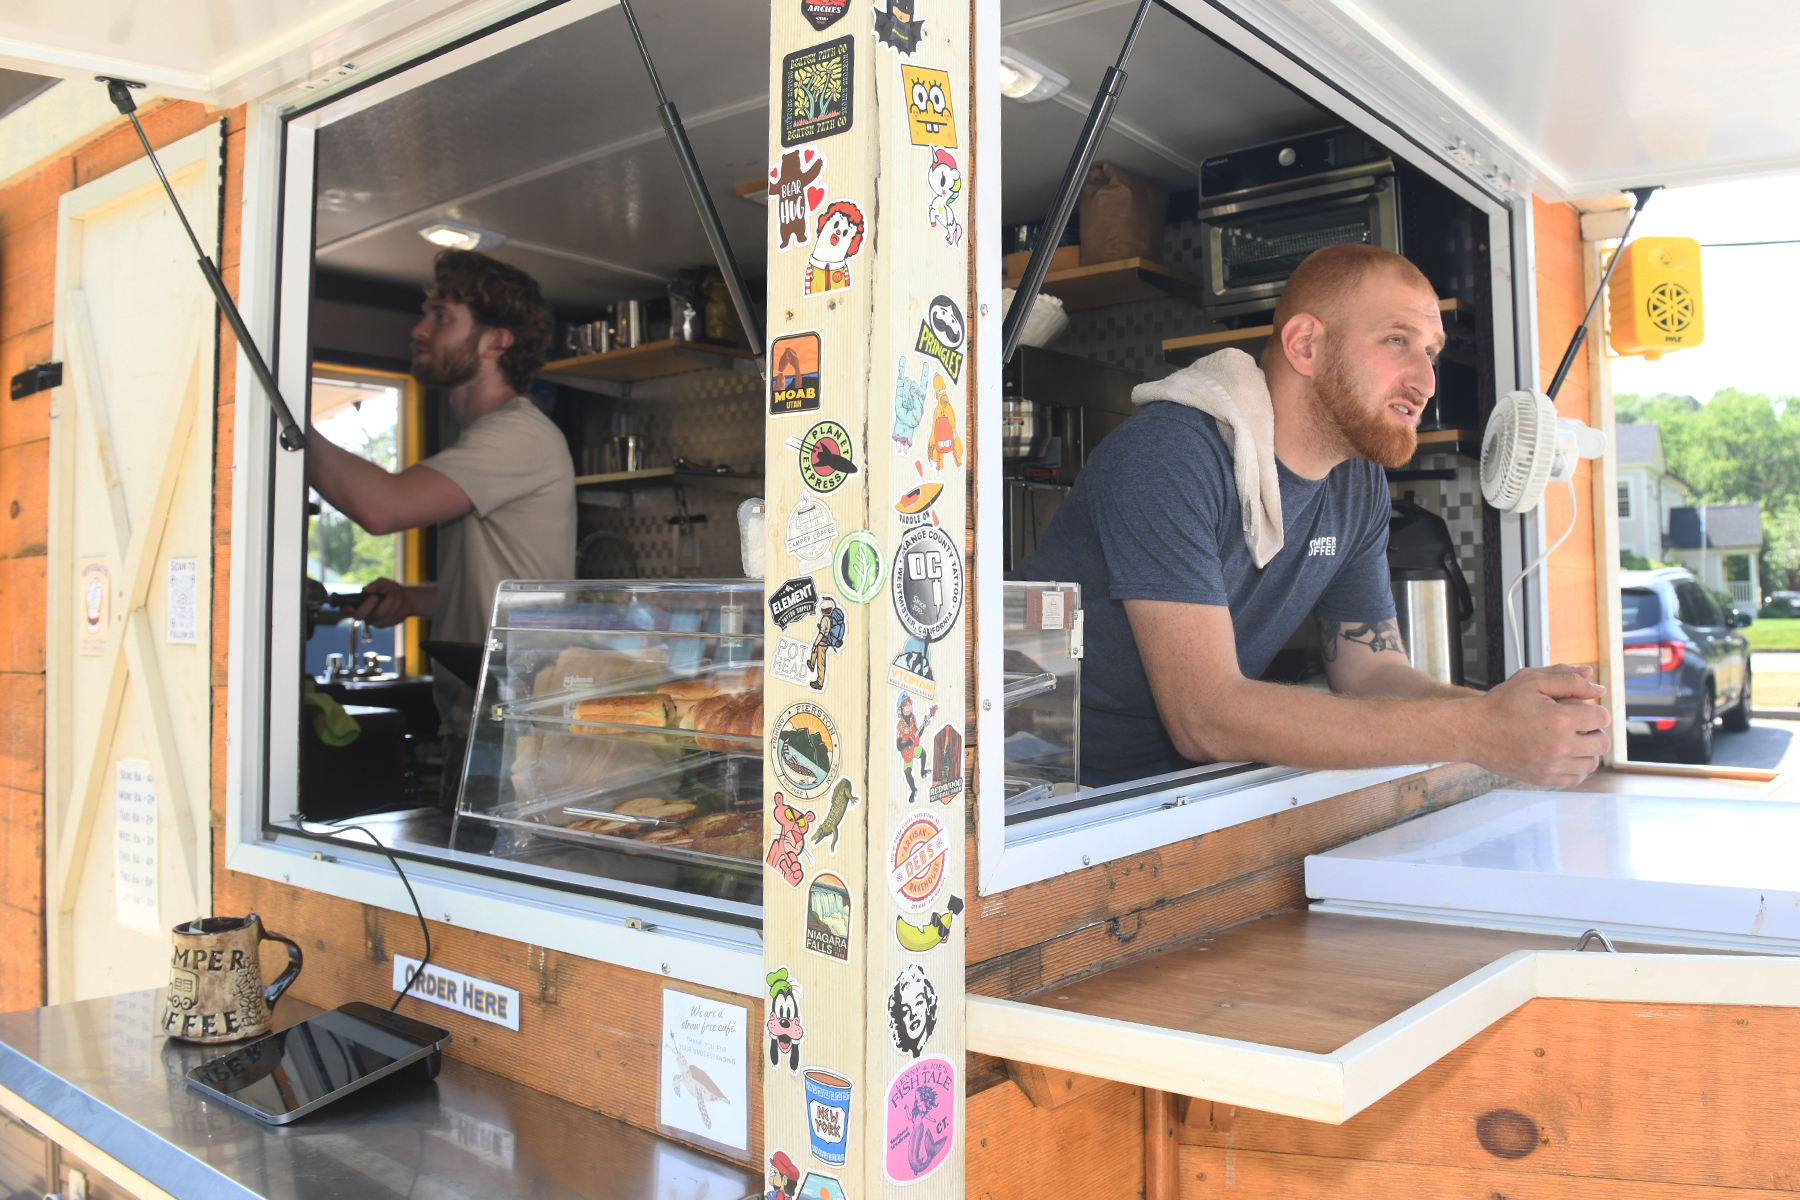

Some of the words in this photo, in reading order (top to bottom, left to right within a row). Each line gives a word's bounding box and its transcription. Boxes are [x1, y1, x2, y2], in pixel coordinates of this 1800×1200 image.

[807, 5, 842, 14] ARCHES
[782, 180, 802, 198] BEAR
[780, 196, 805, 224] HUG
[918, 324, 962, 379] PRINGLES
[774, 388, 816, 403] MOAB
[786, 400, 802, 409] UTAH
[812, 426, 849, 456] PLANET
[802, 456, 842, 489] EXPRESS
[900, 514, 920, 524] PADDLE
[788, 536, 810, 549] CAMPER
[813, 526, 835, 539] COFFEE
[929, 531, 953, 557] COUNTY
[171, 561, 186, 571] SCAN
[907, 551, 941, 581] OC
[772, 584, 812, 615] ELEMENT
[796, 604, 812, 616] SUPPLY
[918, 612, 952, 634] CAIFORNIA
[778, 638, 808, 662] POT
[773, 654, 807, 678] HEAD
[892, 668, 934, 692] VTOMAN
[796, 705, 835, 736] FIERSTON
[826, 763, 838, 785] TEAM
[930, 778, 962, 795] REDWOOD
[903, 829, 926, 852] ARTISAN
[905, 843, 935, 878] DEB'S
[909, 862, 939, 892] BAKEHOUSE
[806, 938, 832, 955] FALLS
[807, 929, 847, 949] NIAGARA
[405, 963, 457, 1004] ORDER
[462, 980, 508, 1020] HERE
[691, 1005, 703, 1017] We
[164, 1010, 241, 1037] FFEE
[682, 1019, 700, 1030] straw
[701, 1019, 716, 1035] free
[718, 1020, 736, 1036] café
[679, 1044, 691, 1052] YOUR
[693, 1049, 736, 1065] UNDERSTANDING
[687, 1037, 702, 1046] THANK
[704, 1042, 714, 1050] YOU
[896, 1066, 920, 1090] LENNY
[930, 1063, 949, 1074] JOE'S
[891, 1075, 920, 1108] FISH
[922, 1071, 952, 1091] TALE
[817, 1106, 839, 1123] NEW
[936, 1117, 949, 1134] CT.
[815, 1118, 841, 1138] YORK
